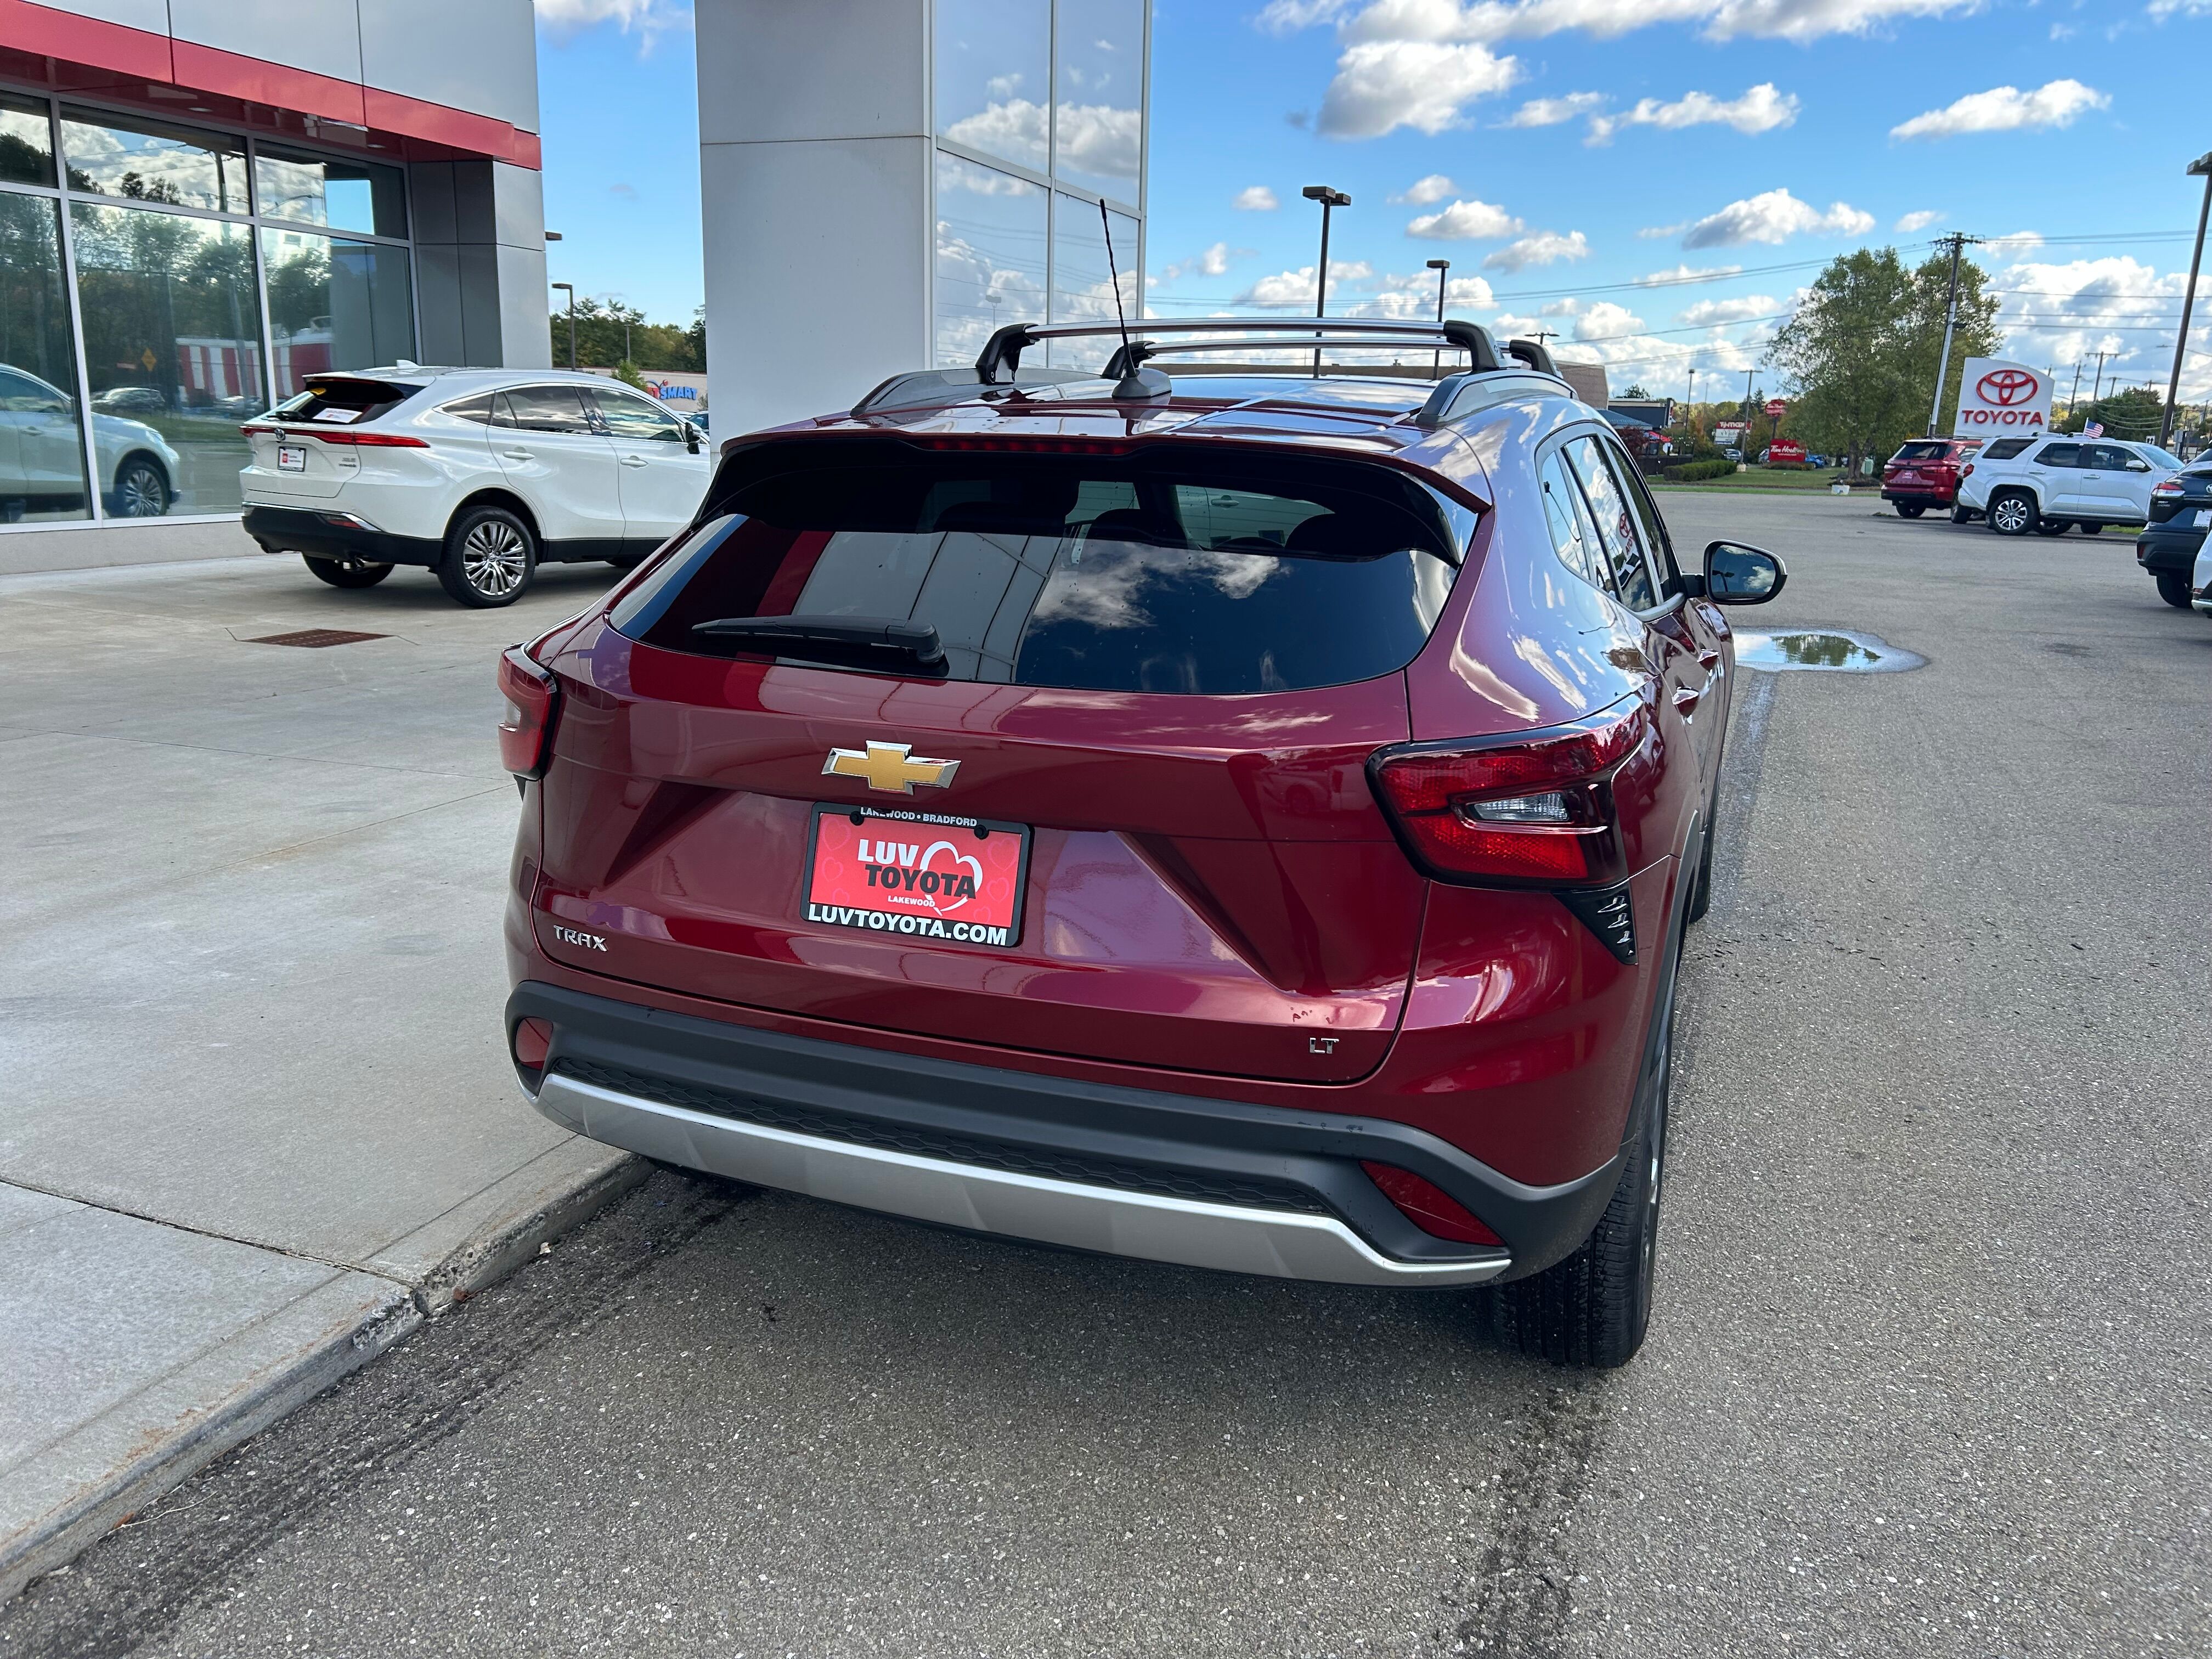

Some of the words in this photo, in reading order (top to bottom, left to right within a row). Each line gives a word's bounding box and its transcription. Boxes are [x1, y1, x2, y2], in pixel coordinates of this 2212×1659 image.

[1962, 410, 2043, 425] TOYOTA
[923, 814, 977, 827] BRADFORD
[858, 839, 919, 867] LUV
[865, 865, 976, 899] TOYOTA
[888, 895, 935, 907] LAKEWOOD
[808, 904, 1007, 946] LUVTOYOTA.COM
[553, 925, 607, 952] TRAX
[1310, 1037, 1340, 1054] LT
